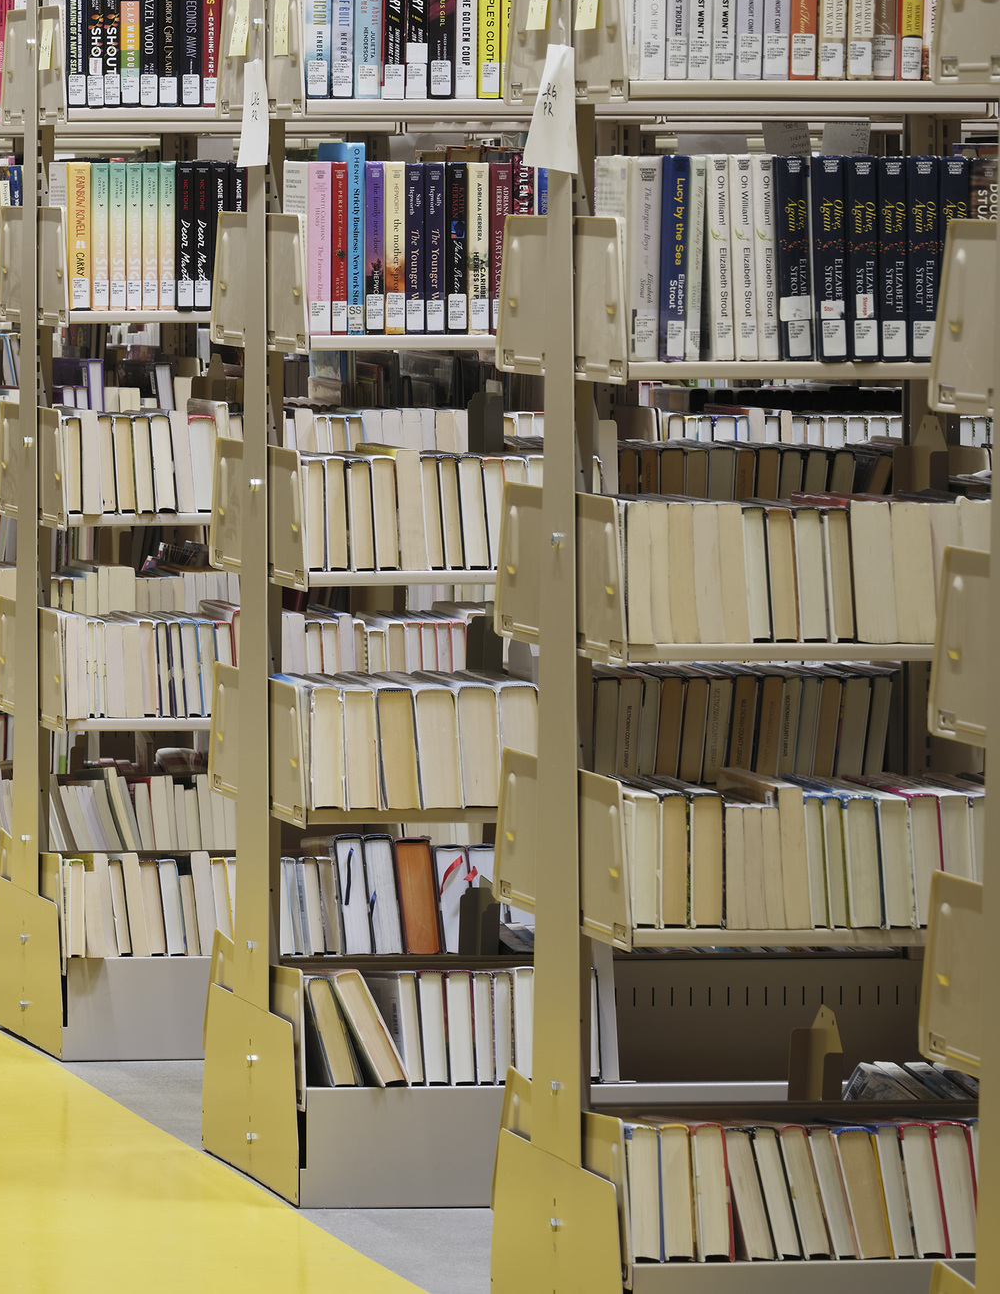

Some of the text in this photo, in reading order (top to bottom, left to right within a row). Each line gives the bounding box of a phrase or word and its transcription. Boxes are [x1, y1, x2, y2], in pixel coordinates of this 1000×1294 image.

[462, 10, 471, 43] GOLDEN
[106, 27, 117, 75] SHOUT
[186, 37, 196, 59] AWAY
[462, 46, 471, 67] COUP
[75, 175, 85, 237] RAINBOW ROWELL
[717, 175, 726, 226] Oh William!
[740, 175, 750, 226] Oh William!
[881, 200, 894, 234] Again
[673, 178, 686, 266] Lucy by the Sea
[75, 252, 85, 277] CARRY
[408, 248, 420, 288] Younger
[720, 248, 729, 318] Elizabeth Strout
[743, 248, 753, 318] Elizabeth Strout
[669, 280, 678, 309] Strout
[677, 273, 686, 315] Elizabeth
[896, 261, 904, 313] ELIZABETH
[349, 306, 362, 315] SS
